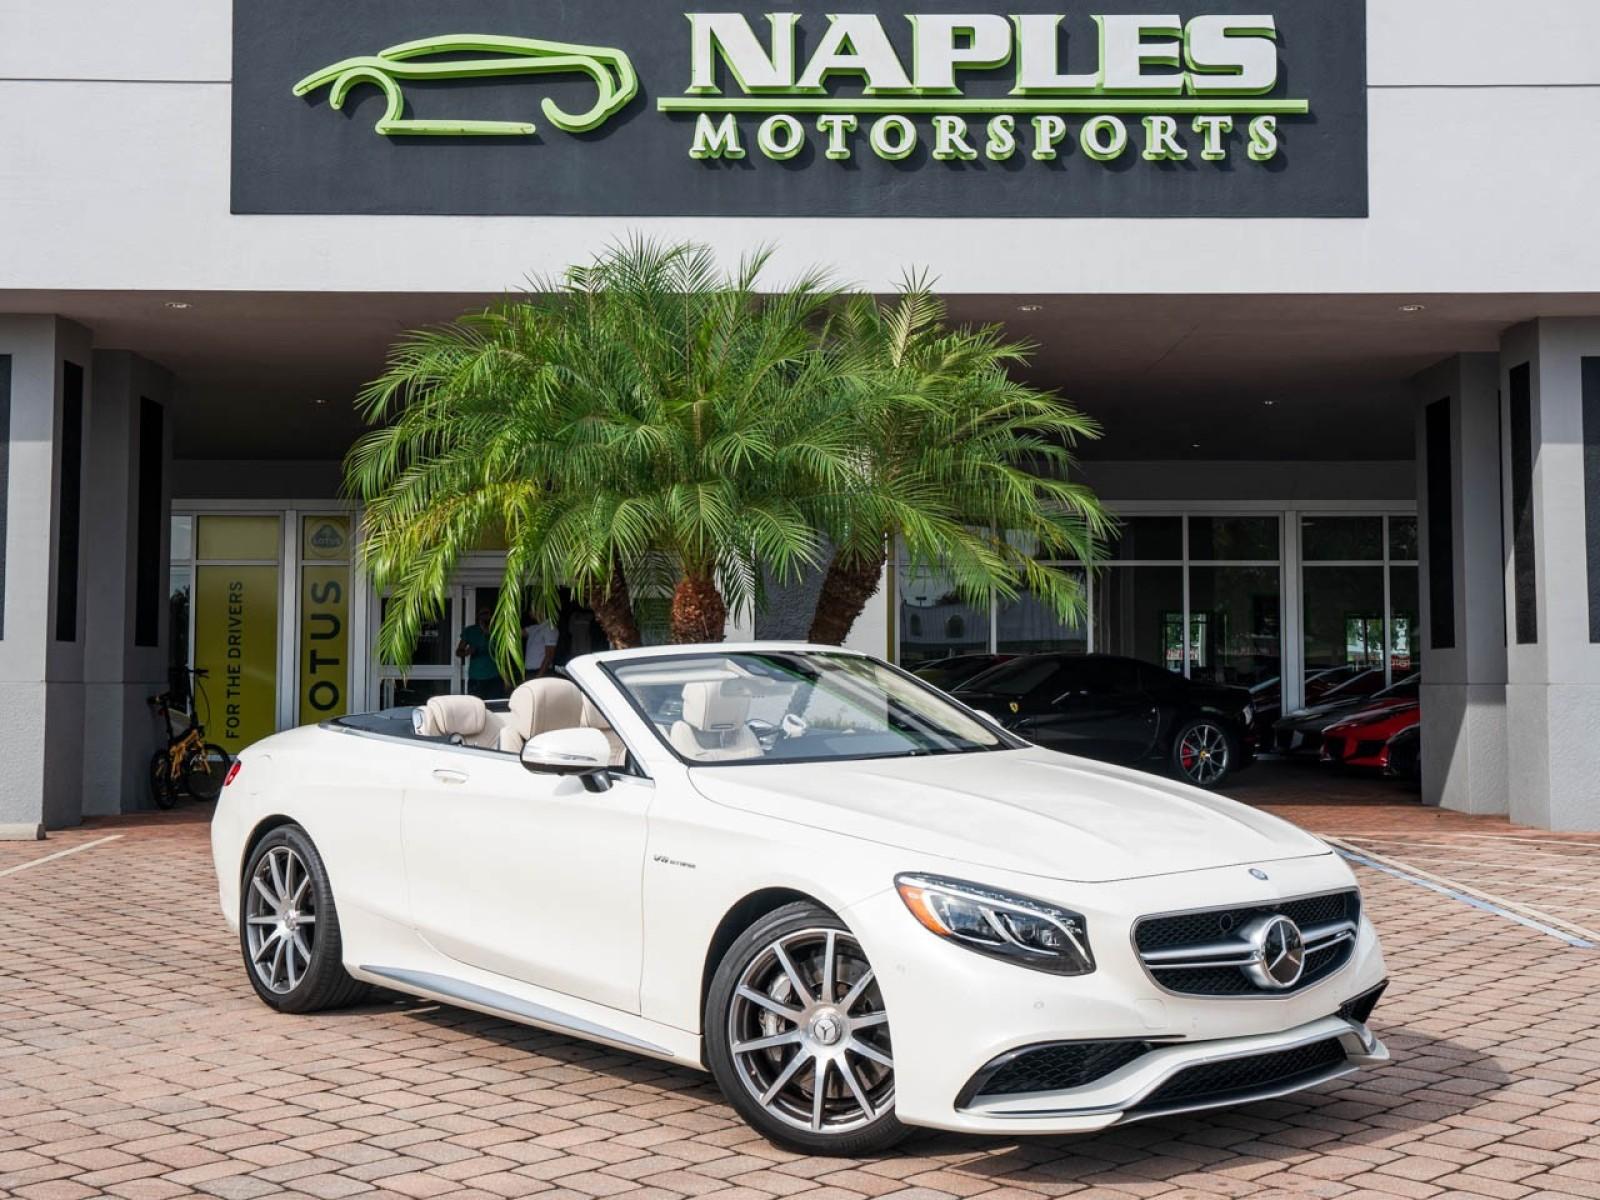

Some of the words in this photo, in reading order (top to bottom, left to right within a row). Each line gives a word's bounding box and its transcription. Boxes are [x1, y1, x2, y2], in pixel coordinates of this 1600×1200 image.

[684, 12, 1279, 95] NAPLES
[689, 113, 1279, 161] MOTORSPORTS
[227, 580, 243, 657] DRIVERS
[308, 580, 342, 711] OTUS
[226, 664, 241, 698] THE
[226, 703, 241, 739] FOR
